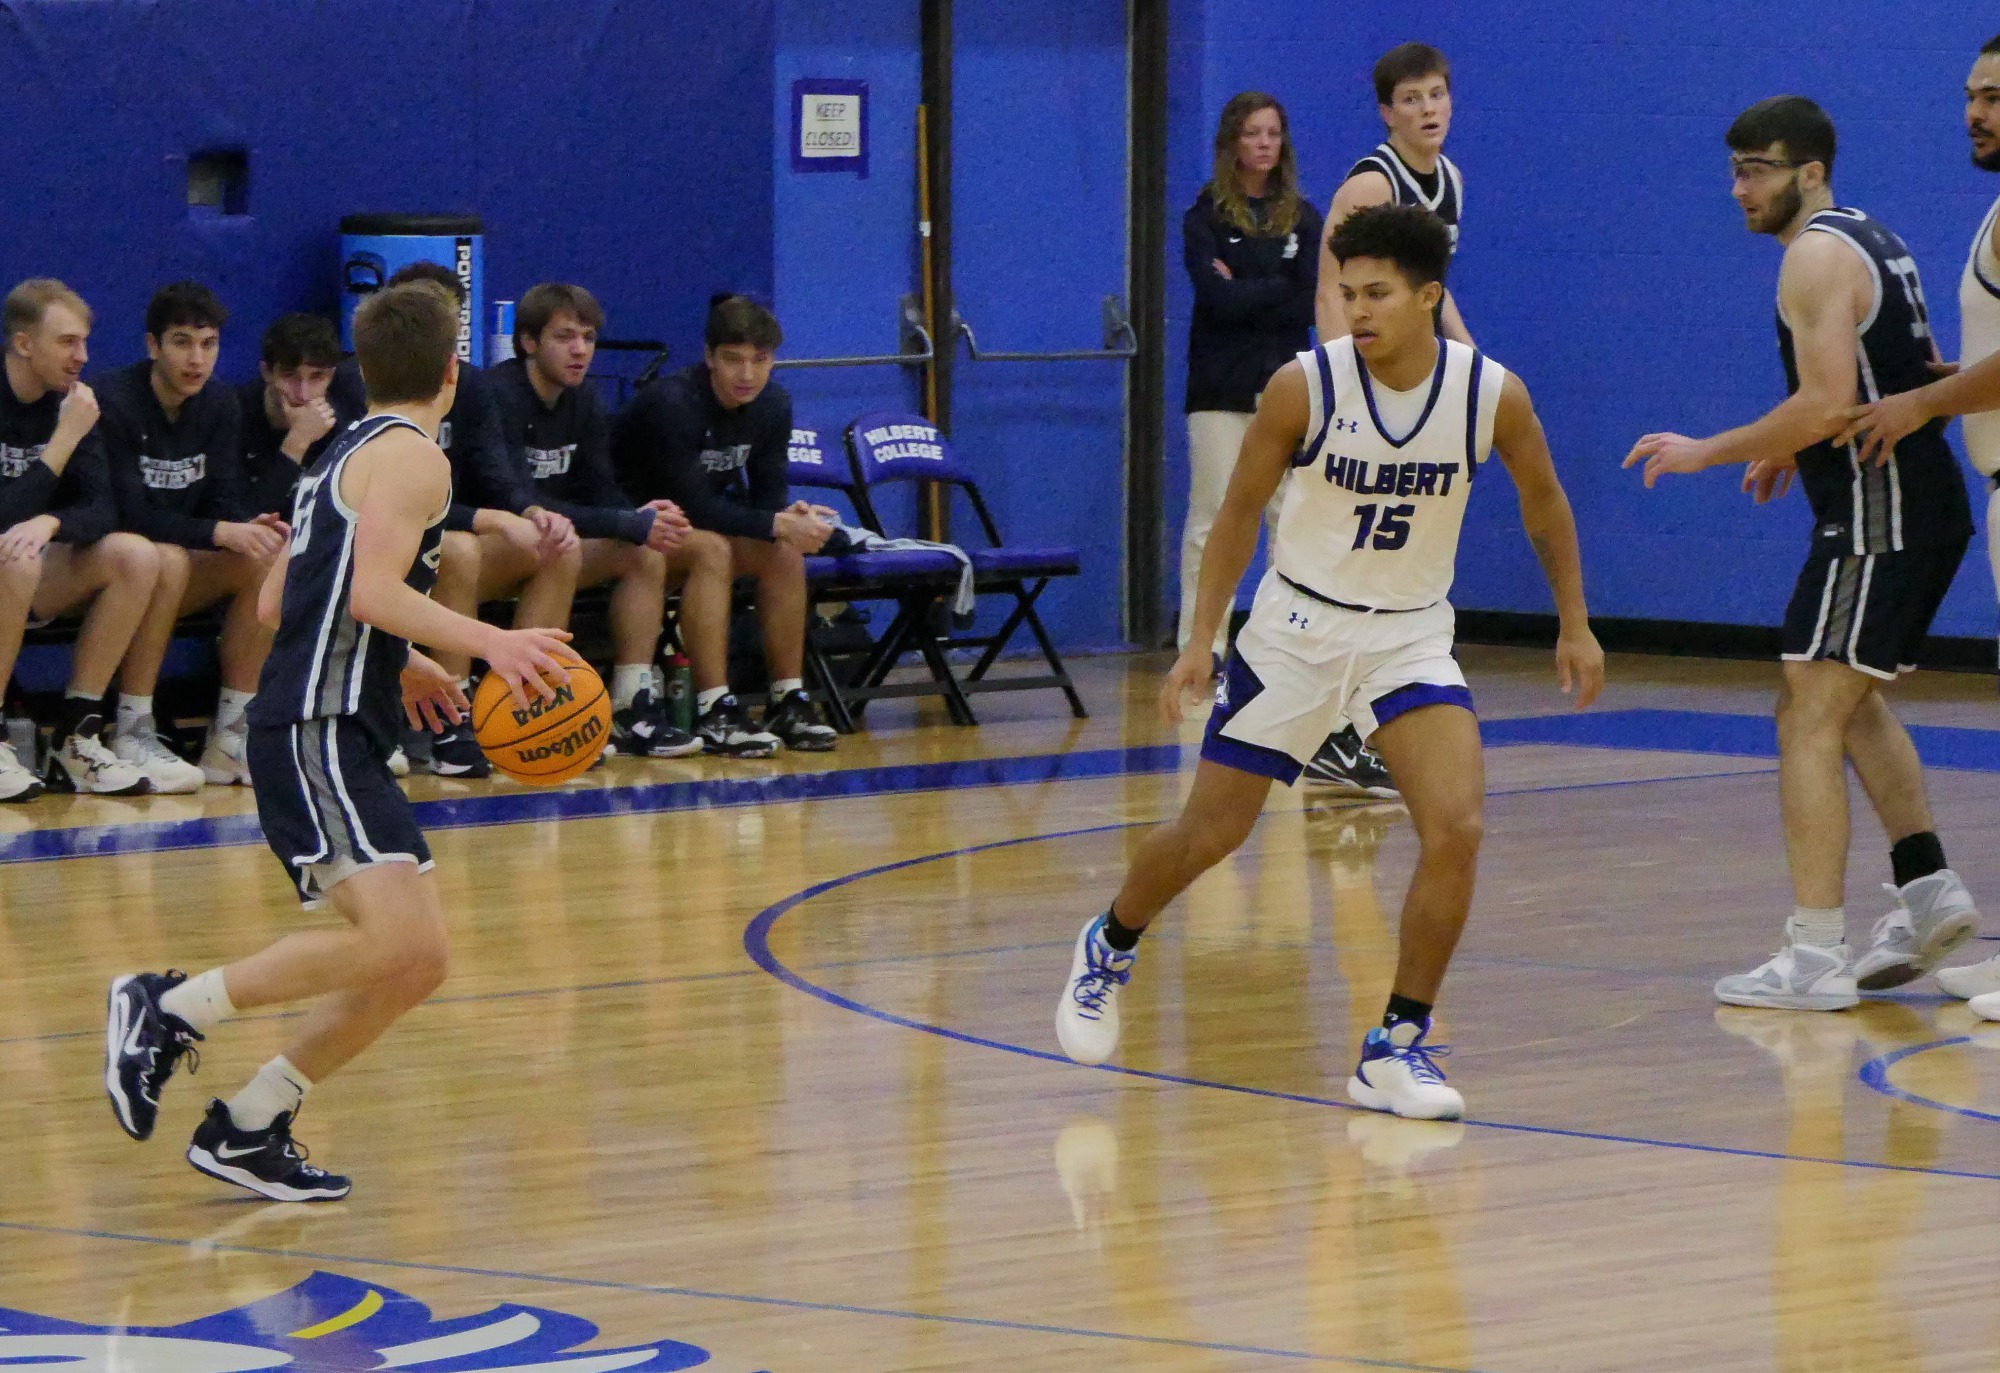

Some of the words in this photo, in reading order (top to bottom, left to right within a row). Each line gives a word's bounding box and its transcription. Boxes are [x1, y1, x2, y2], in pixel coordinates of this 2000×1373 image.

[863, 424, 938, 447] HILBERT
[873, 442, 944, 464] COLLEGE
[1324, 452, 1460, 498] HILBERT
[1350, 503, 1416, 552] 15
[516, 714, 603, 763] Wilson
